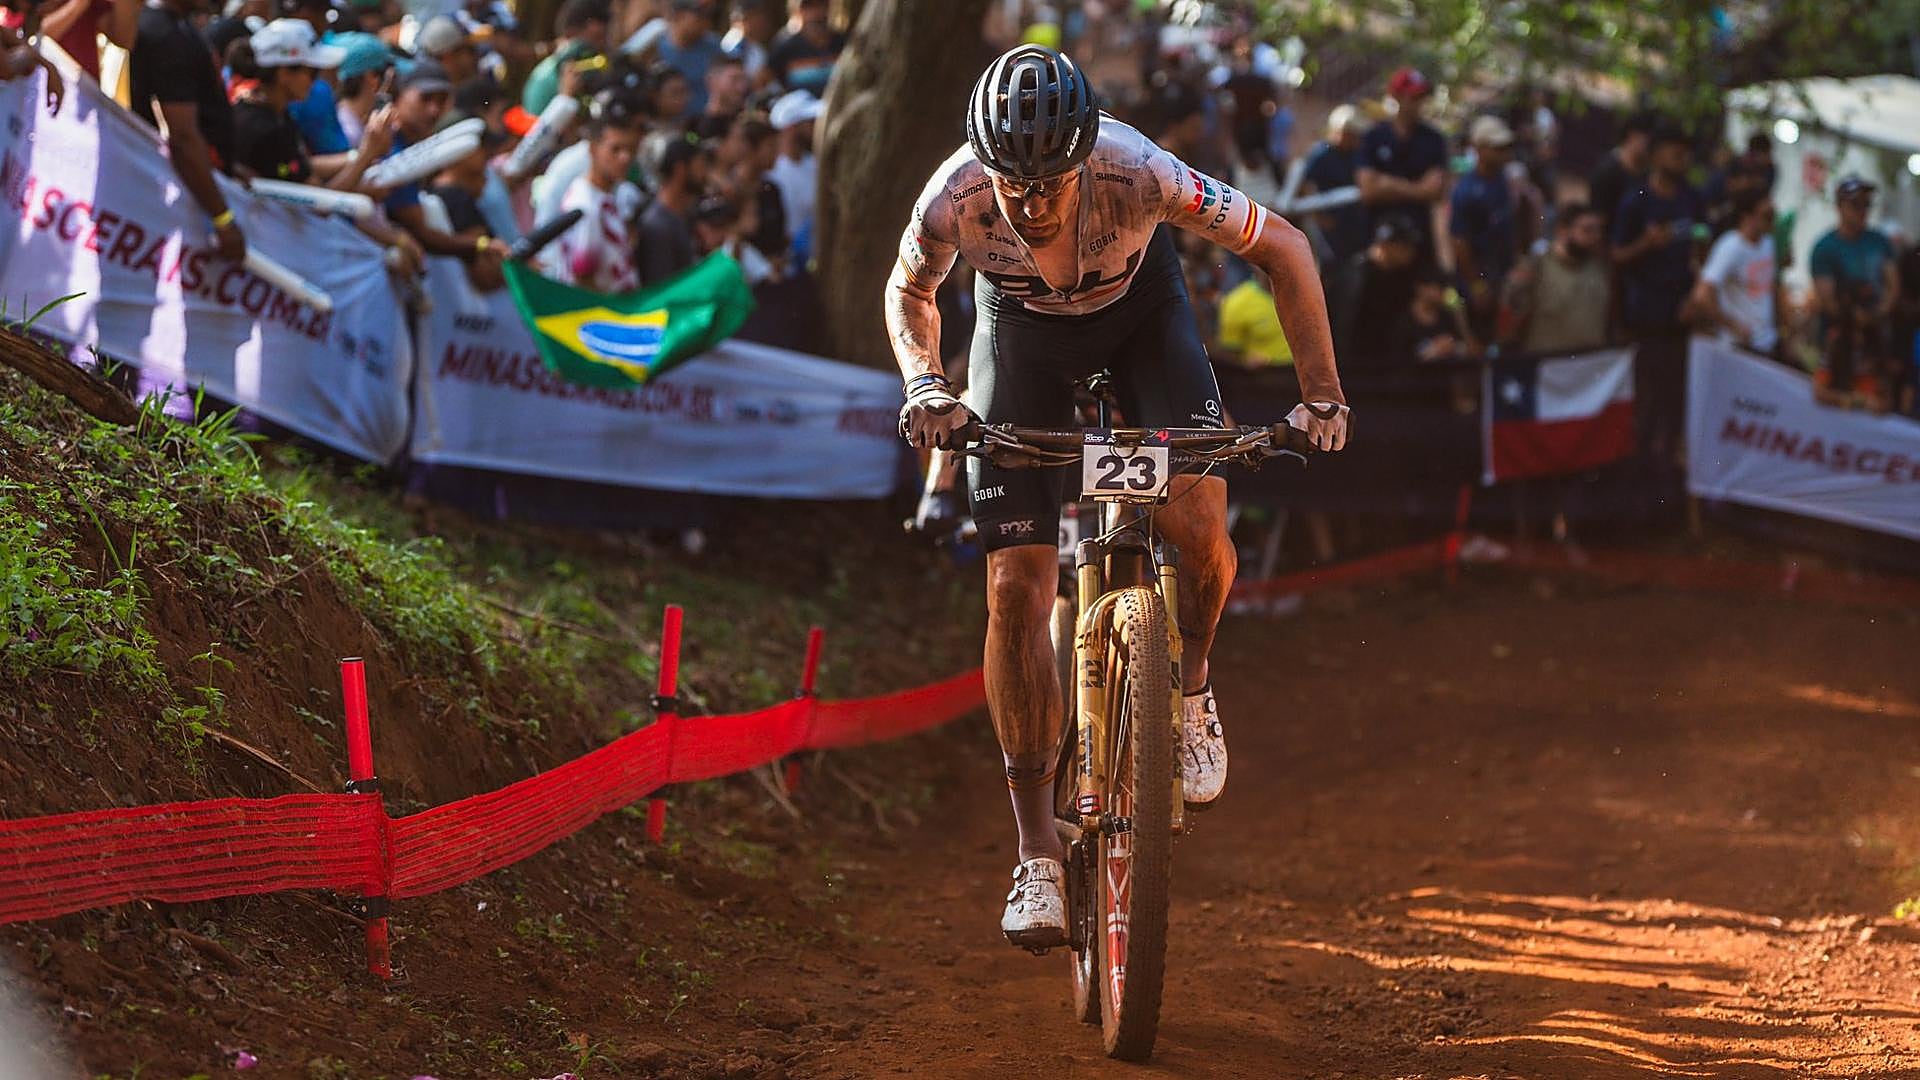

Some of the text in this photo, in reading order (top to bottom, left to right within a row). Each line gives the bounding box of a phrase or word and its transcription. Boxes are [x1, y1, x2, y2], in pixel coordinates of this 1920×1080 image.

[1095, 172, 1133, 186] SHIMANO
[953, 179, 992, 203] SHIMANO
[1089, 229, 1118, 252] GOBIK
[1095, 455, 1157, 491] 23
[974, 485, 1006, 502] GOBIK
[999, 520, 1035, 537] FOX
